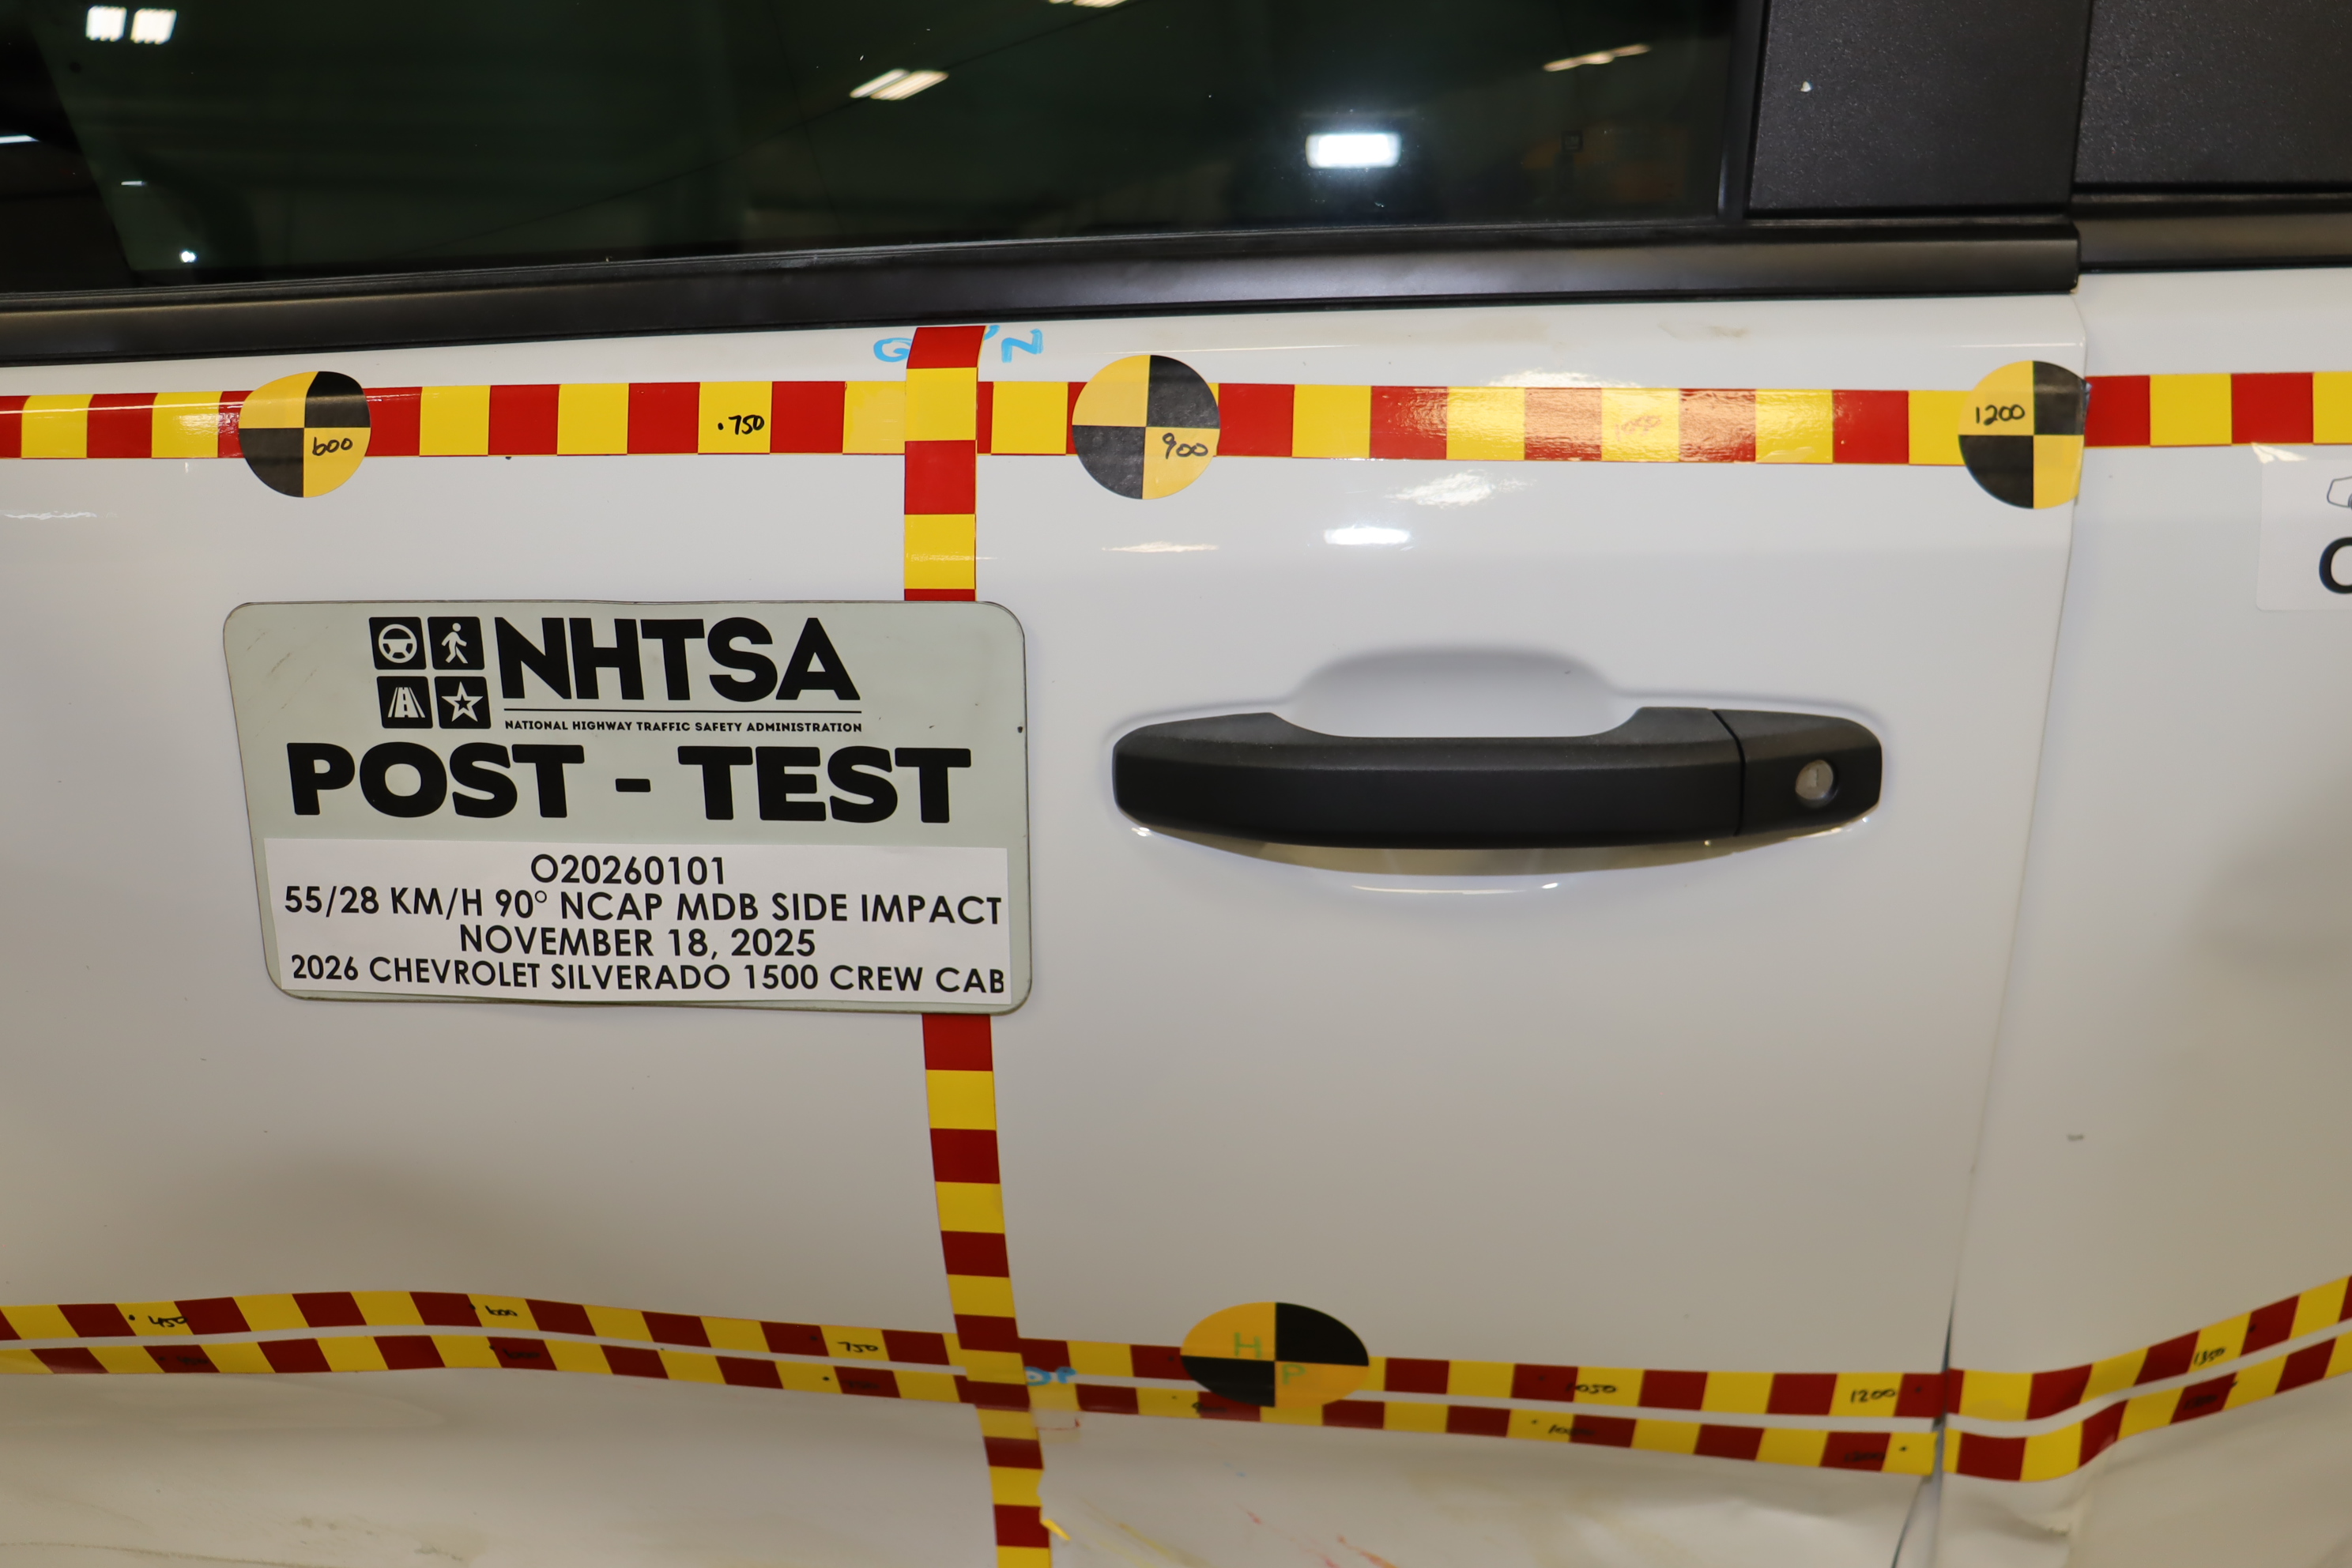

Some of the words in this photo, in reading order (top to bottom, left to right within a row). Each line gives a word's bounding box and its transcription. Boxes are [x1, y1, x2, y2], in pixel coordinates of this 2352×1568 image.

[728, 414, 765, 435] 750
[1976, 404, 2025, 425] 1200
[312, 436, 353, 457] 600
[1162, 432, 1208, 460] 900
[495, 616, 861, 703] NHTSA
[504, 720, 569, 730] NATIONAL
[572, 721, 633, 731] HIGHWAY
[635, 721, 691, 732] TRAFFIC
[695, 722, 743, 732] SAFETY
[746, 722, 862, 733] ADMINISTRATION
[286, 741, 585, 819] POST
[677, 745, 971, 824] TEST
[285, 885, 379, 918] 55/28
[390, 887, 483, 921] KM/H
[495, 888, 548, 918] 90°
[560, 891, 662, 921] NCAP
[677, 892, 759, 921] MDB
[771, 892, 848, 922] SIDE
[861, 894, 1002, 925] IMPACT
[460, 924, 654, 957] NOVEMBER
[668, 928, 718, 960] 18,
[731, 928, 816, 957] 2025
[291, 954, 359, 981] 2026
[369, 956, 541, 988] CHEVROLET
[551, 963, 730, 990] SILVERADO
[744, 964, 819, 989] 1500
[830, 964, 923, 992] CREW
[936, 967, 1004, 994] CAB
[148, 1314, 189, 1328] 450
[837, 1341, 879, 1353] 750
[1234, 1332, 1263, 1359] H
[1282, 1363, 1306, 1385] P
[1850, 1389, 1896, 1404] 1200
